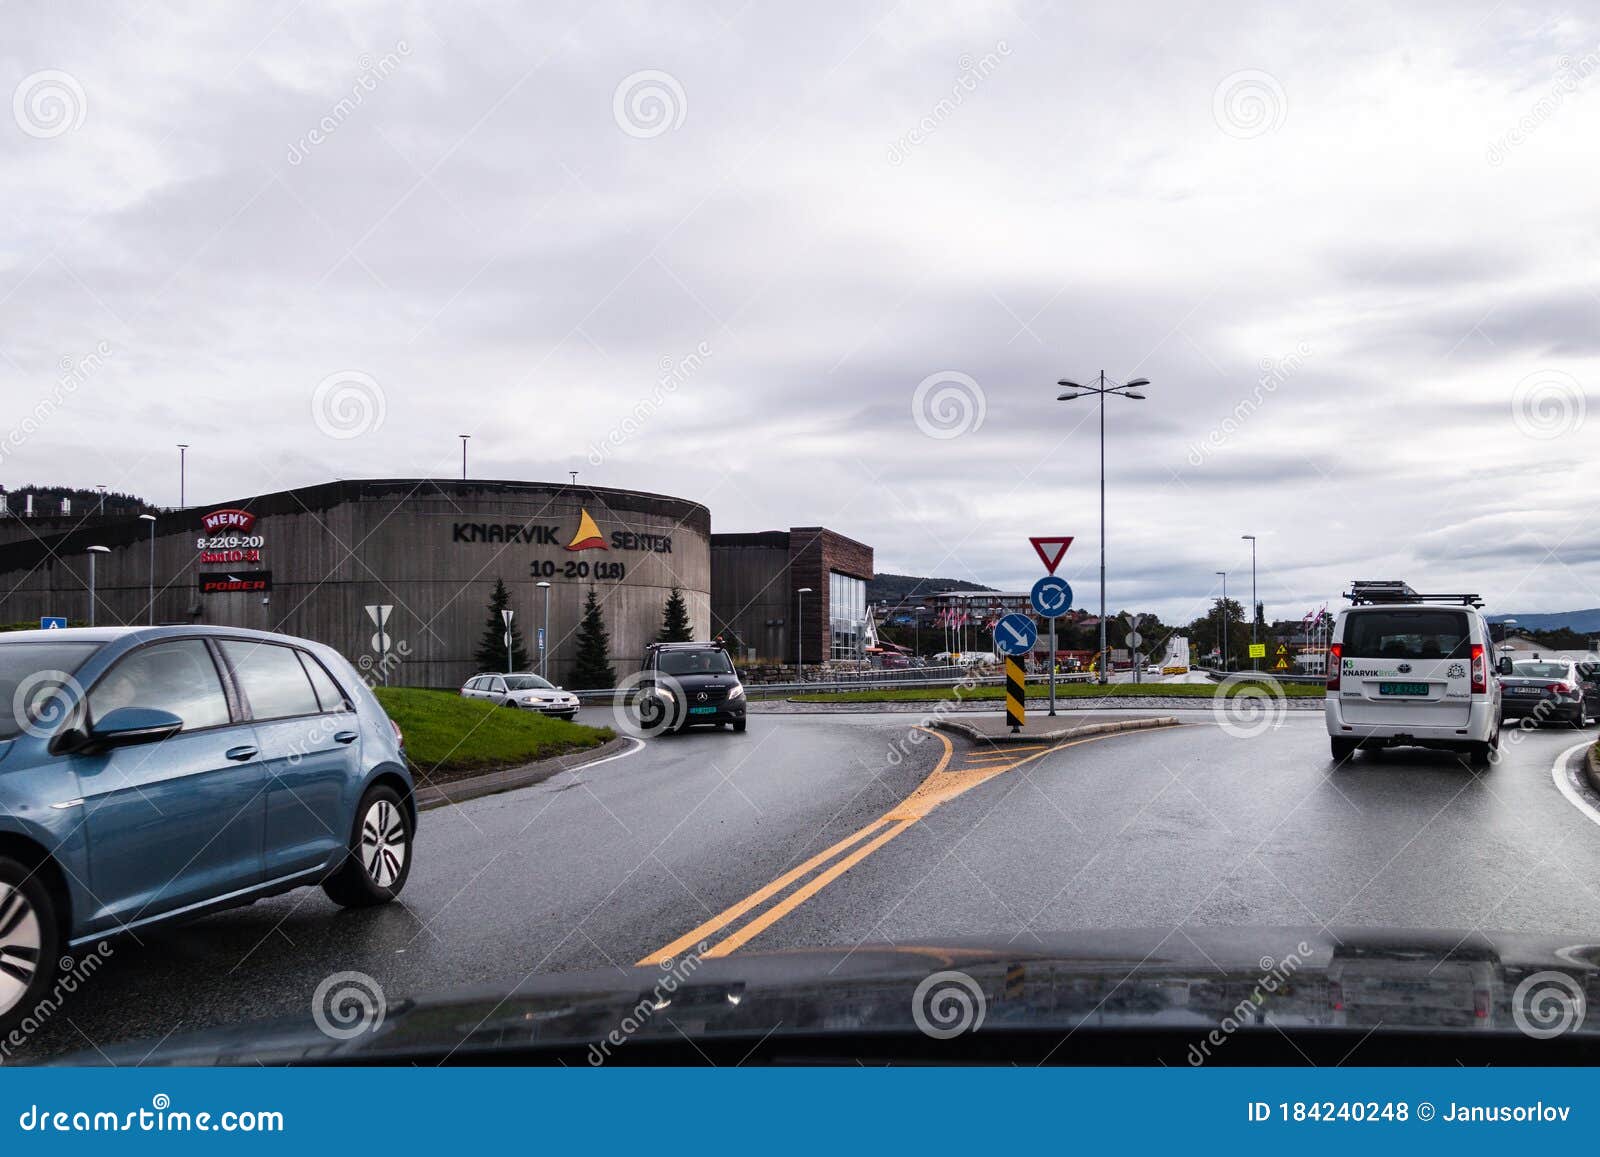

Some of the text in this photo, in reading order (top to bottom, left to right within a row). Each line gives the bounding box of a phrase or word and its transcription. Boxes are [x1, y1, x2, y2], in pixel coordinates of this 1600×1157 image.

[206, 513, 248, 528] MENY
[196, 535, 264, 549] 8-22(9-20)
[453, 523, 673, 553] KNARVIK SENTER
[530, 559, 625, 580] 10-20 (18)
[204, 580, 267, 591] POWER
